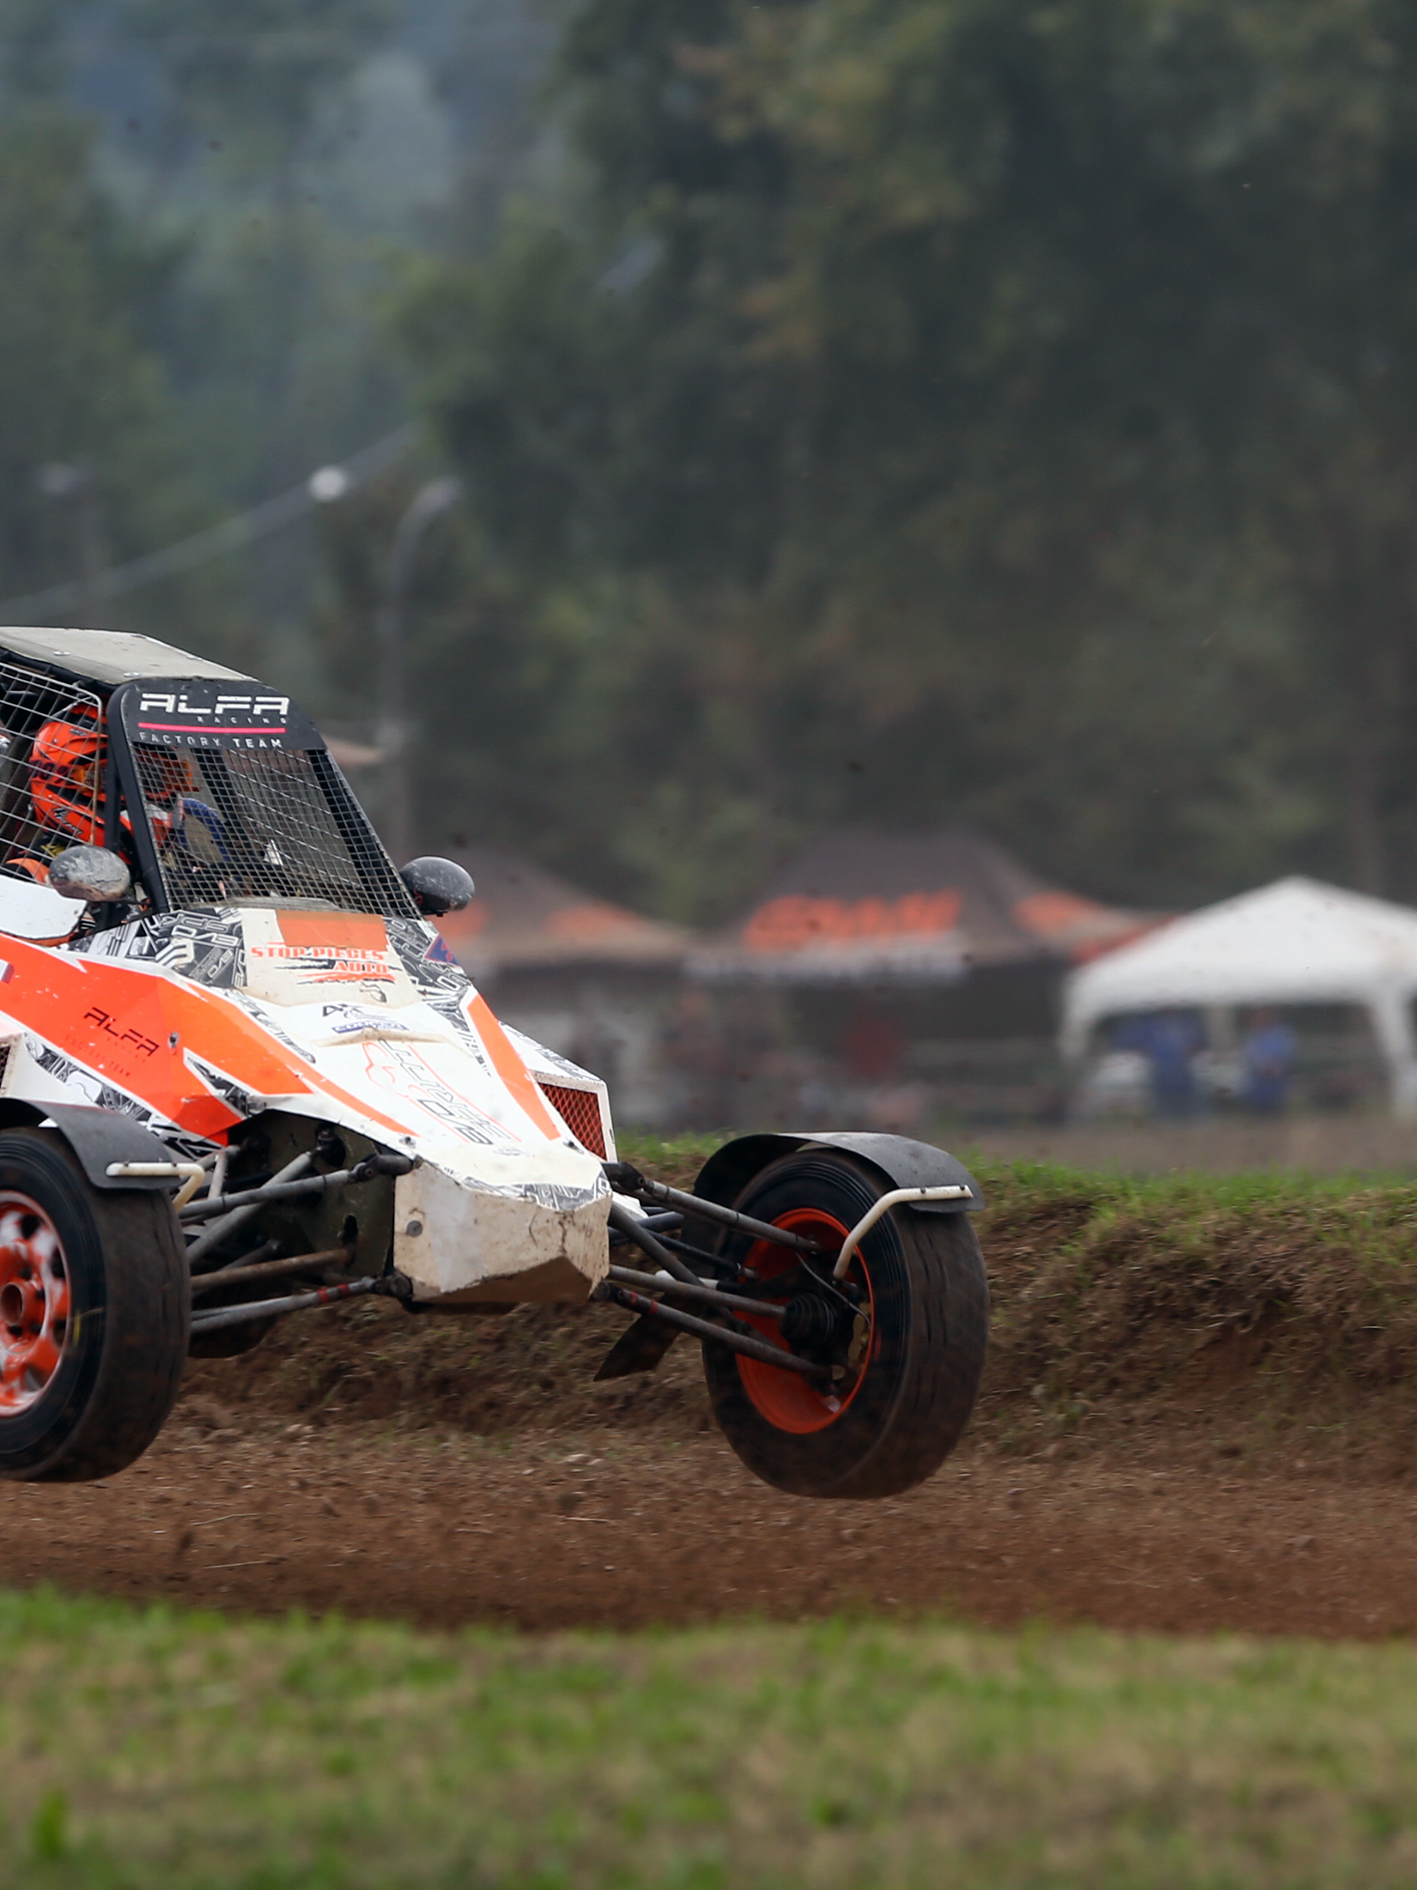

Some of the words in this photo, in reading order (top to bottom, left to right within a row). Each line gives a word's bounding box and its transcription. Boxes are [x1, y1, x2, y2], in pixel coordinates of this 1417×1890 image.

[139, 692, 289, 715] ALFA
[197, 715, 287, 724] RACING
[139, 732, 222, 747] FACTORY
[233, 738, 283, 749] TEAM
[334, 960, 390, 975] AUTO
[83, 1006, 159, 1055] ALFA
